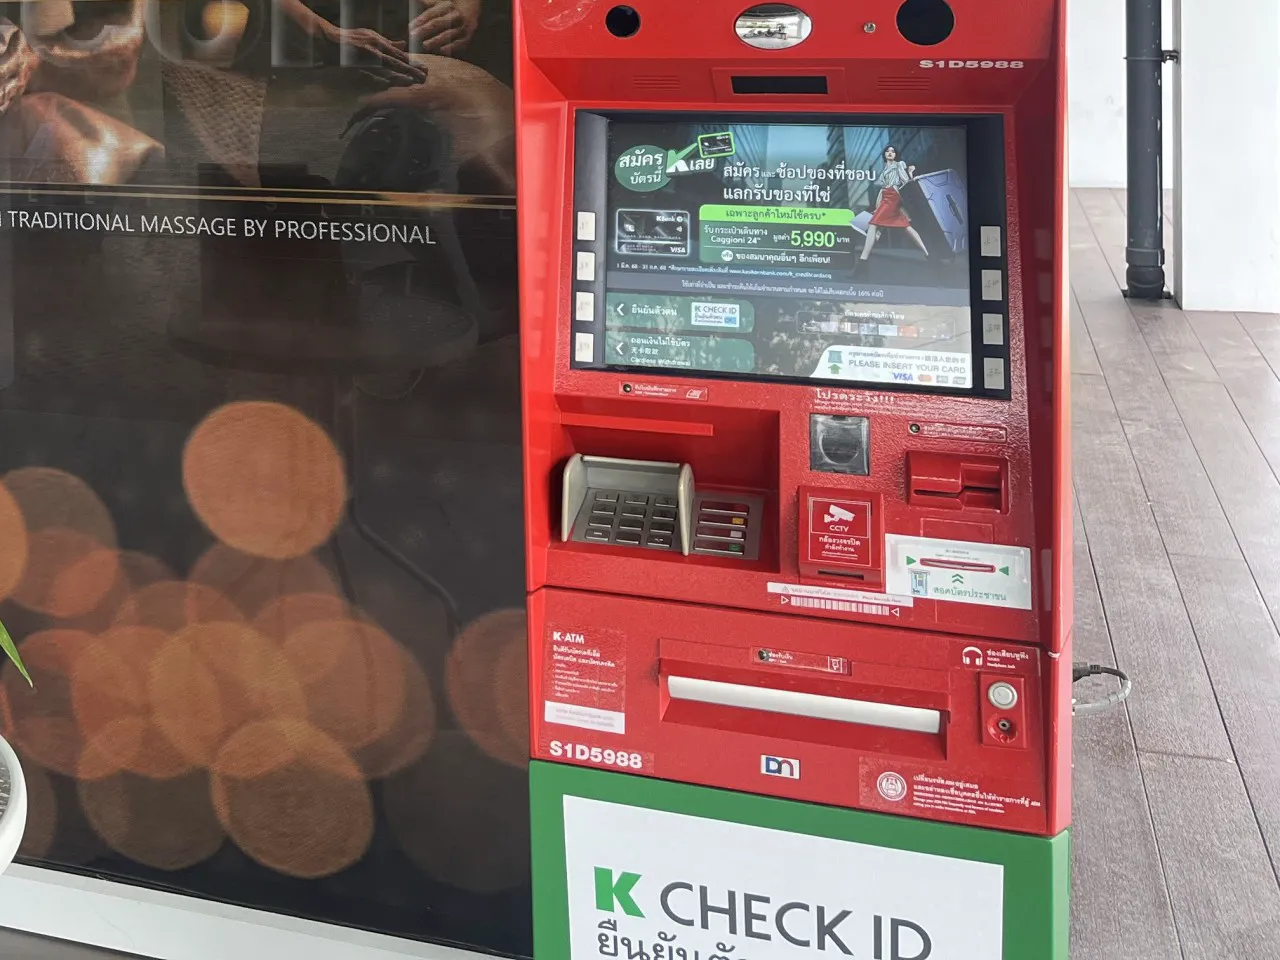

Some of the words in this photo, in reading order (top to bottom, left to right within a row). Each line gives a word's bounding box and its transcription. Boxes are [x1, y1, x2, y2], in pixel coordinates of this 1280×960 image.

[919, 60, 1024, 69] S1D5988
[619, 148, 663, 168] สมัคร
[630, 166, 663, 184] บัตรนี้
[723, 182, 831, 203] แลกรับของที่ใช่
[7, 210, 135, 232] TRADITIONAL
[141, 215, 237, 236] MASSAGE
[244, 219, 268, 238] BY
[275, 220, 437, 244] PROFESSIONAL
[703, 306, 727, 315] CHECK
[728, 307, 737, 315] ID
[848, 359, 881, 369] PLEASE
[882, 361, 913, 371] INSERT
[915, 363, 940, 373] YOUR
[941, 365, 966, 374] CARD
[892, 372, 913, 382] VISA
[933, 586, 1007, 601] สอดบัตรประชาชน
[553, 631, 584, 644] K-ATM
[549, 740, 643, 769] S1D5988
[594, 866, 646, 918] K
[659, 882, 853, 956] CHECK
[872, 914, 933, 960] ID
